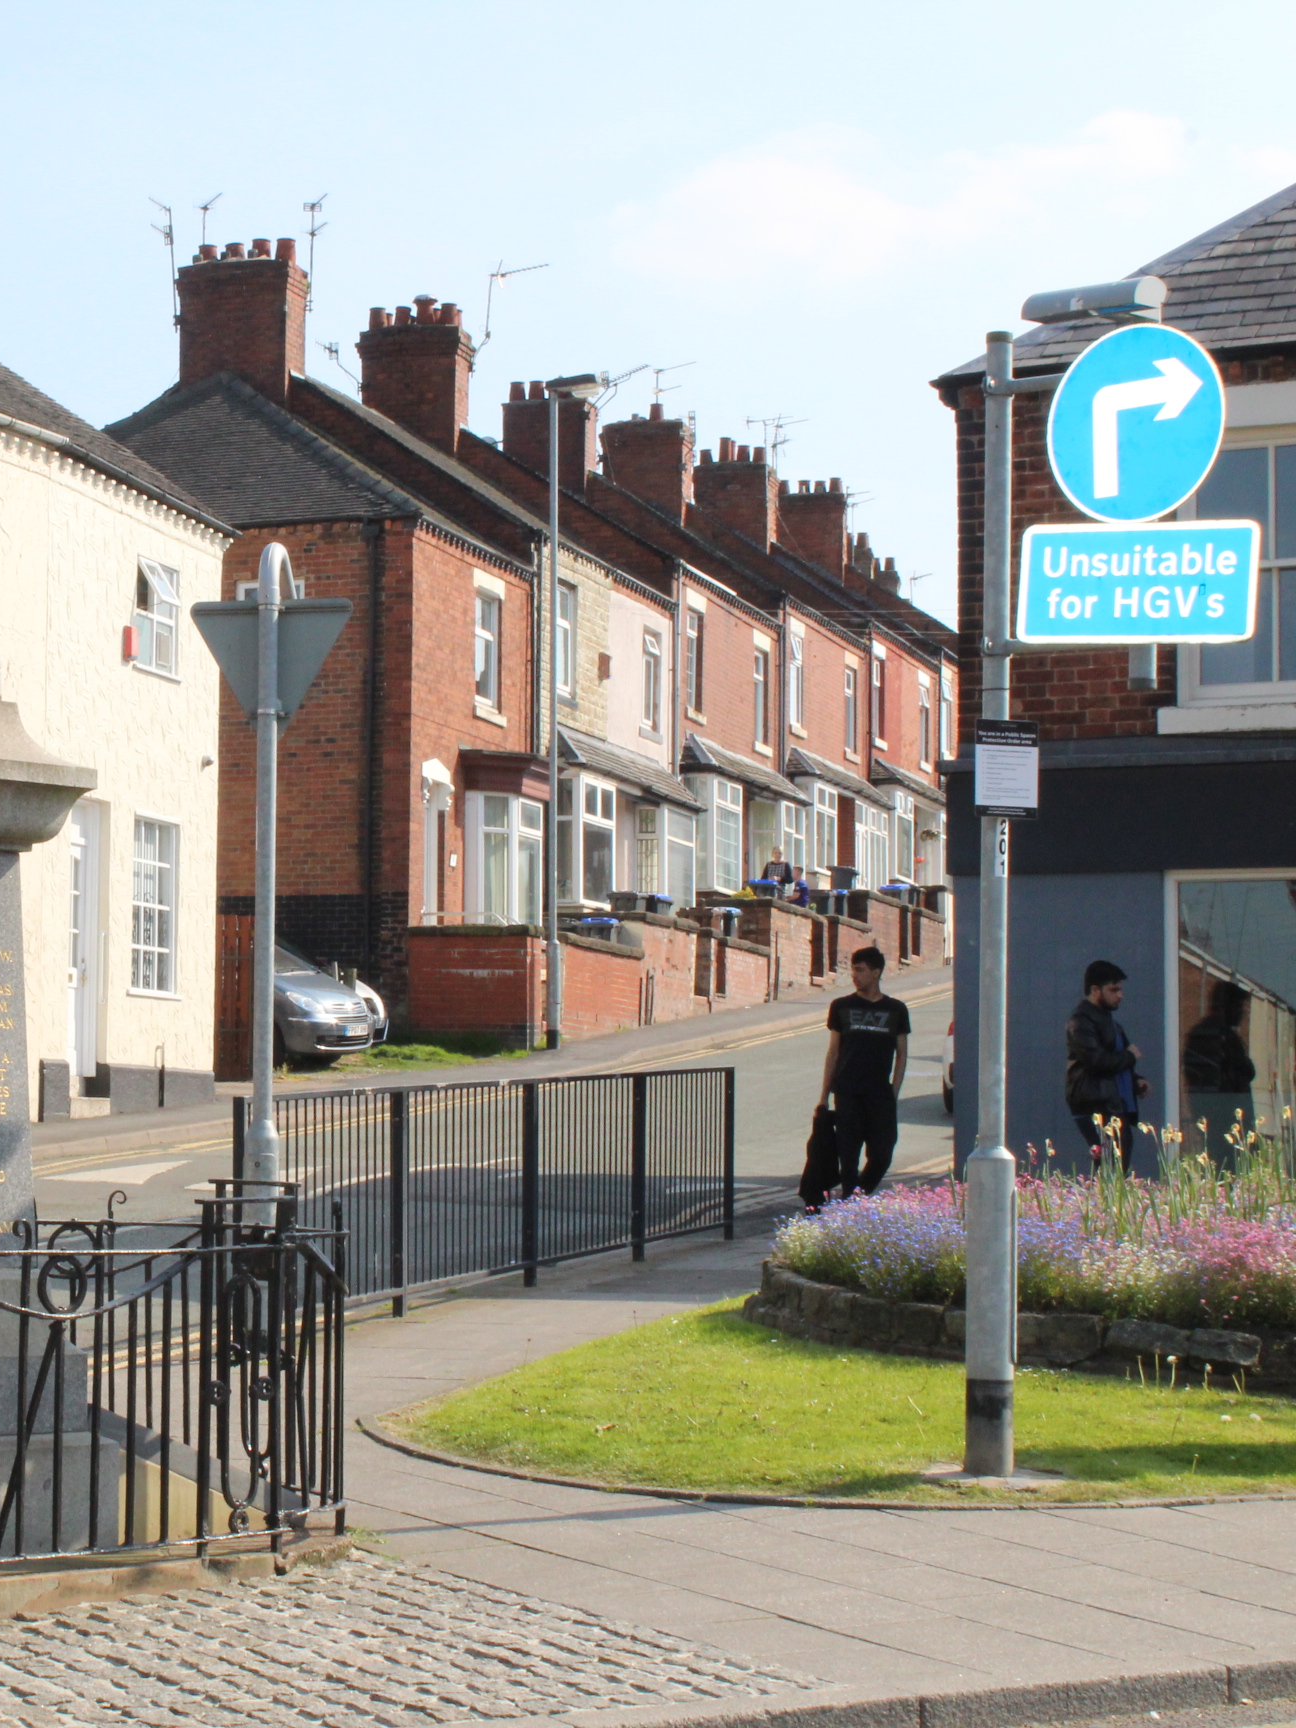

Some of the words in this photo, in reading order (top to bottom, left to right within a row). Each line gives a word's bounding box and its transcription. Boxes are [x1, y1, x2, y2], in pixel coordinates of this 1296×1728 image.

[1043, 543, 1237, 578] Unsuitable
[1047, 588, 1098, 619] for
[850, 1010, 889, 1026] EA7
